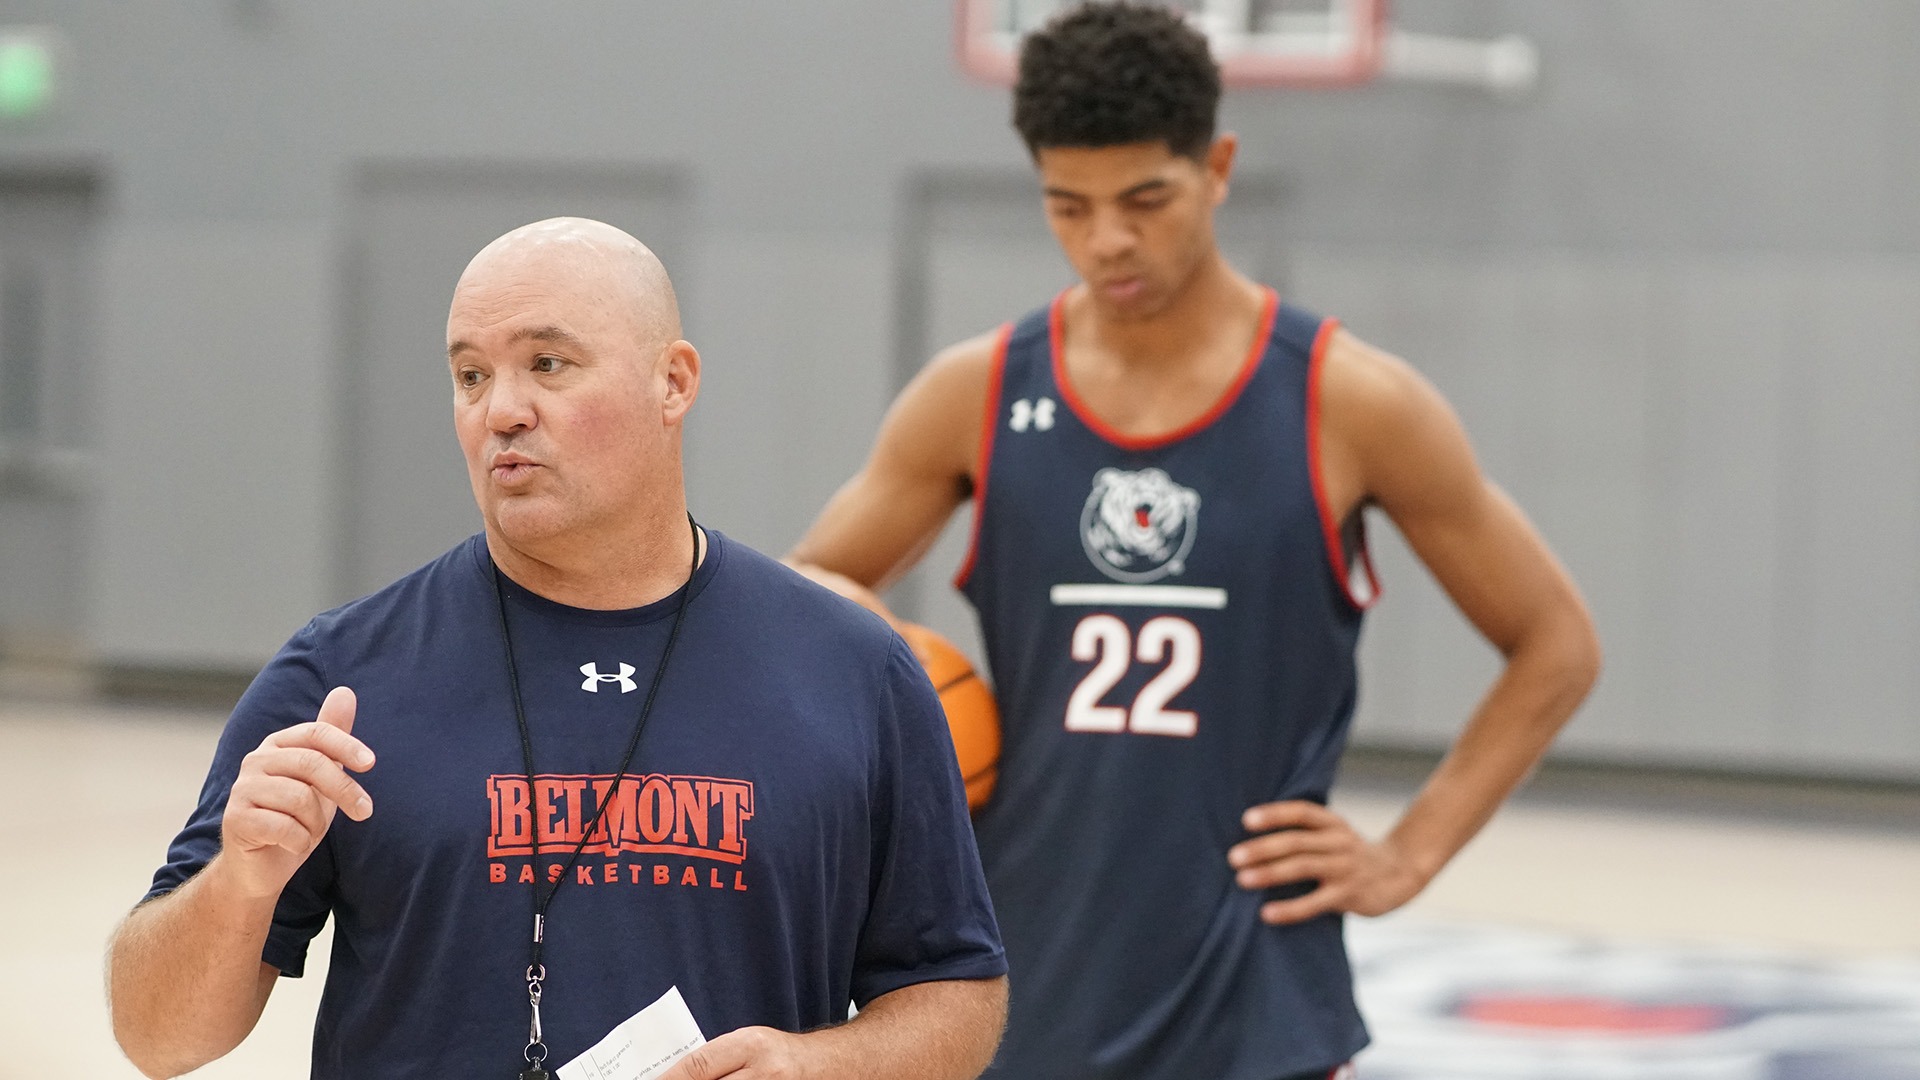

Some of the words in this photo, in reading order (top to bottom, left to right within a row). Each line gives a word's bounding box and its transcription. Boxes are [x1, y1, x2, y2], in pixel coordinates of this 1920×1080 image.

[1065, 612, 1203, 737] 22
[490, 776, 752, 858] BELMONT
[489, 863, 747, 891] BASKETBALL
